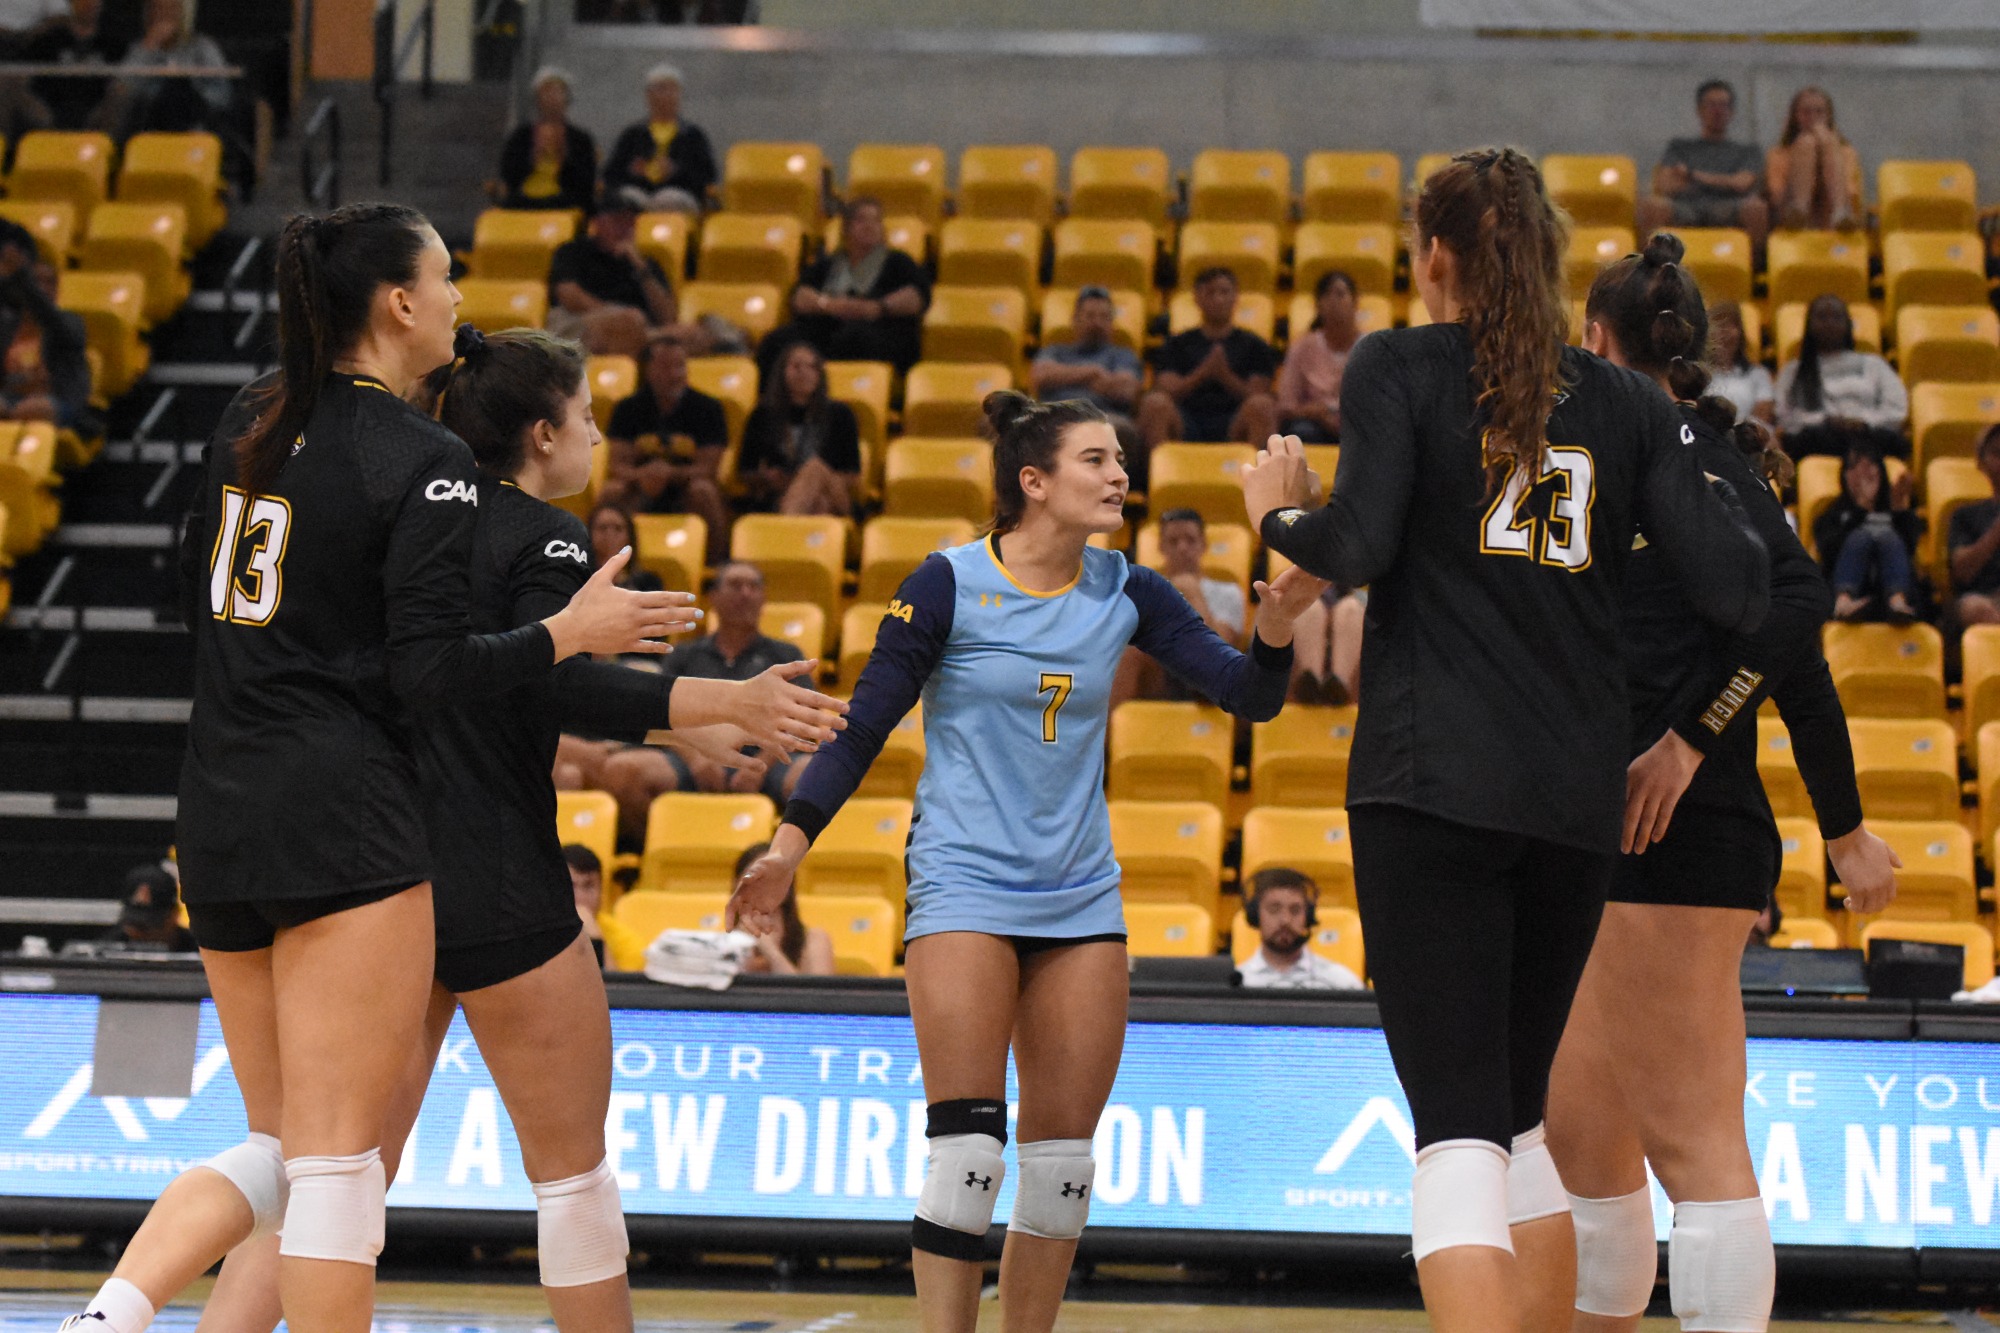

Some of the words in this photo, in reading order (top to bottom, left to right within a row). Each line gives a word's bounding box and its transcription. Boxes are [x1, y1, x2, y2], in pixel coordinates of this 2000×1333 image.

[425, 479, 478, 507] CAA
[1479, 427, 1596, 573] 23
[210, 484, 292, 627] 13
[544, 539, 588, 564] CAA
[884, 599, 914, 624] AA
[1037, 671, 1075, 744] 7
[1698, 666, 1764, 736] TOUGH
[614, 1041, 765, 1082] OUR
[1745, 1071, 1818, 1109] KE
[1864, 1073, 2000, 1112] YOU
[445, 1086, 503, 1187] A
[604, 1091, 728, 1193] EW
[1759, 1120, 1812, 1222] A
[1844, 1122, 2000, 1226] NEW
